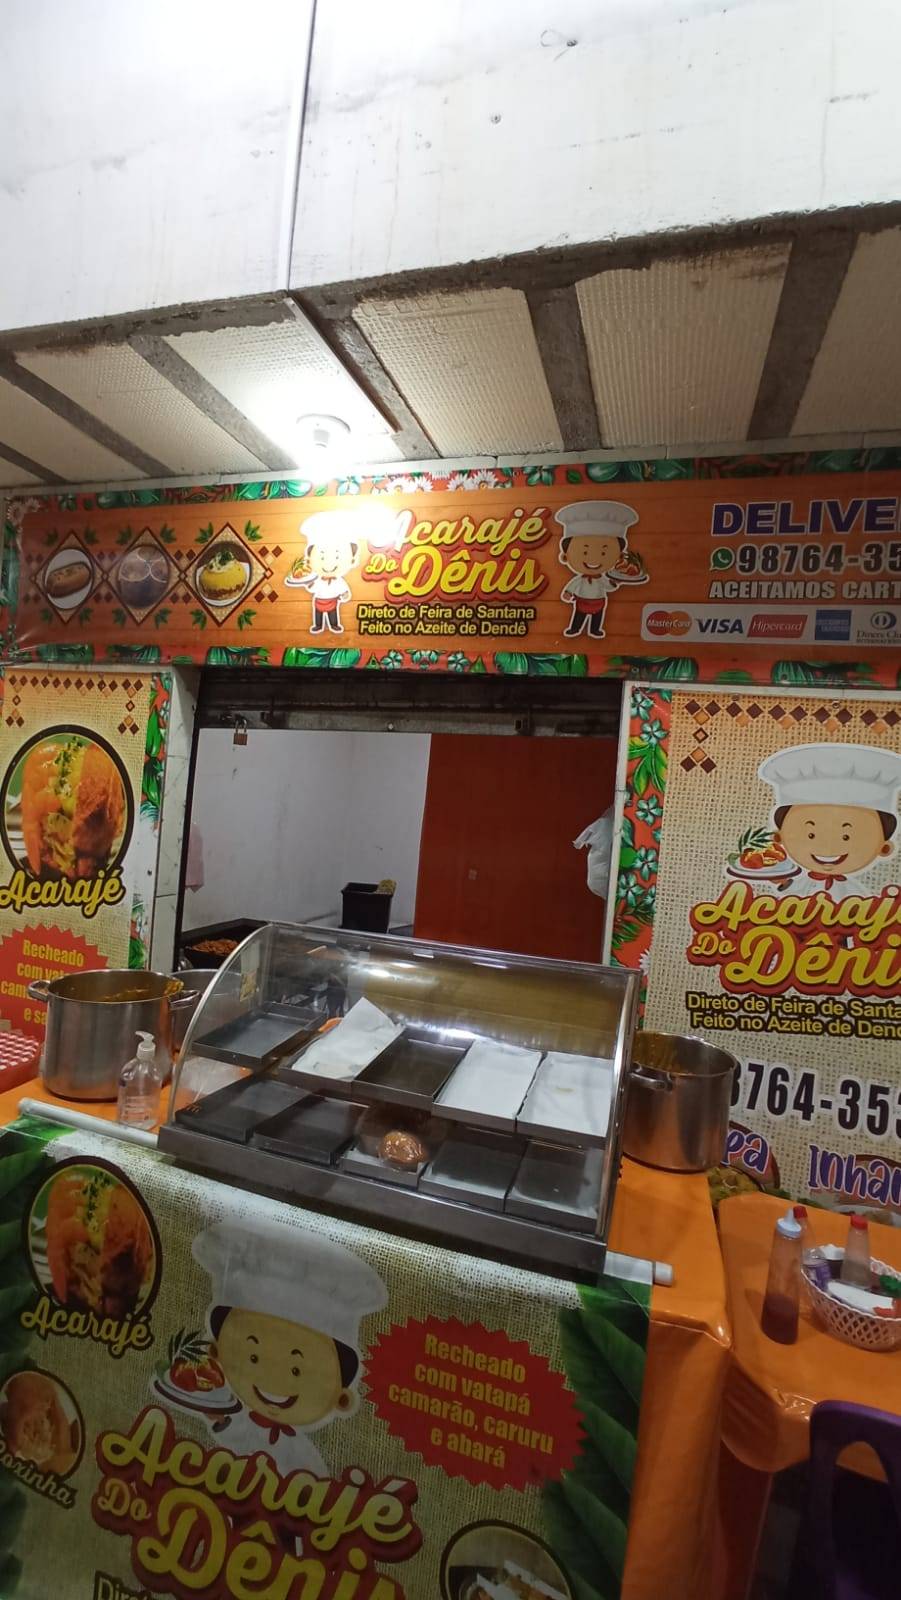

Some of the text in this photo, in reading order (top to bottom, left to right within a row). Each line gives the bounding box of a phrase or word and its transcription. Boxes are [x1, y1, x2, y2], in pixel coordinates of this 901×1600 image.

[367, 508, 547, 556] Acarajé
[711, 498, 901, 536] DELIVE
[365, 545, 546, 597] Do Dênis
[709, 580, 835, 599] ACEITAMOS
[358, 605, 536, 620] Direto de Feira de Santana
[360, 620, 528, 636] Feito no Azeite de Dendê
[647, 618, 692, 630] MasterCard
[696, 618, 745, 635] VISA
[751, 620, 804, 634] Hipercard
[0, 867, 124, 914] Acarajé
[694, 880, 901, 942] Acaraj
[17, 963, 43, 980] com
[23, 939, 84, 967] Recheado
[691, 924, 901, 987] Do Dêni
[1, 980, 32, 1000] cam
[687, 994, 740, 1011] Direto
[744, 997, 766, 1012] de
[771, 998, 816, 1014] Feira
[821, 1000, 845, 1016] de
[24, 1007, 48, 1025] e sa
[692, 1012, 736, 1029] Feito
[740, 1016, 763, 1030] no
[767, 1016, 824, 1035] Azeite
[828, 1018, 852, 1035] de
[730, 1061, 901, 1138] 764-35
[720, 1129, 769, 1173] pa
[21, 1297, 151, 1356] Acarajé
[424, 1333, 526, 1384] Recheado
[415, 1363, 531, 1416] com vatapá
[388, 1384, 553, 1455] camarão, caruru
[430, 1427, 506, 1469] e abará
[97, 1478, 152, 1522] Do
[101, 1407, 413, 1552] Acarajé
